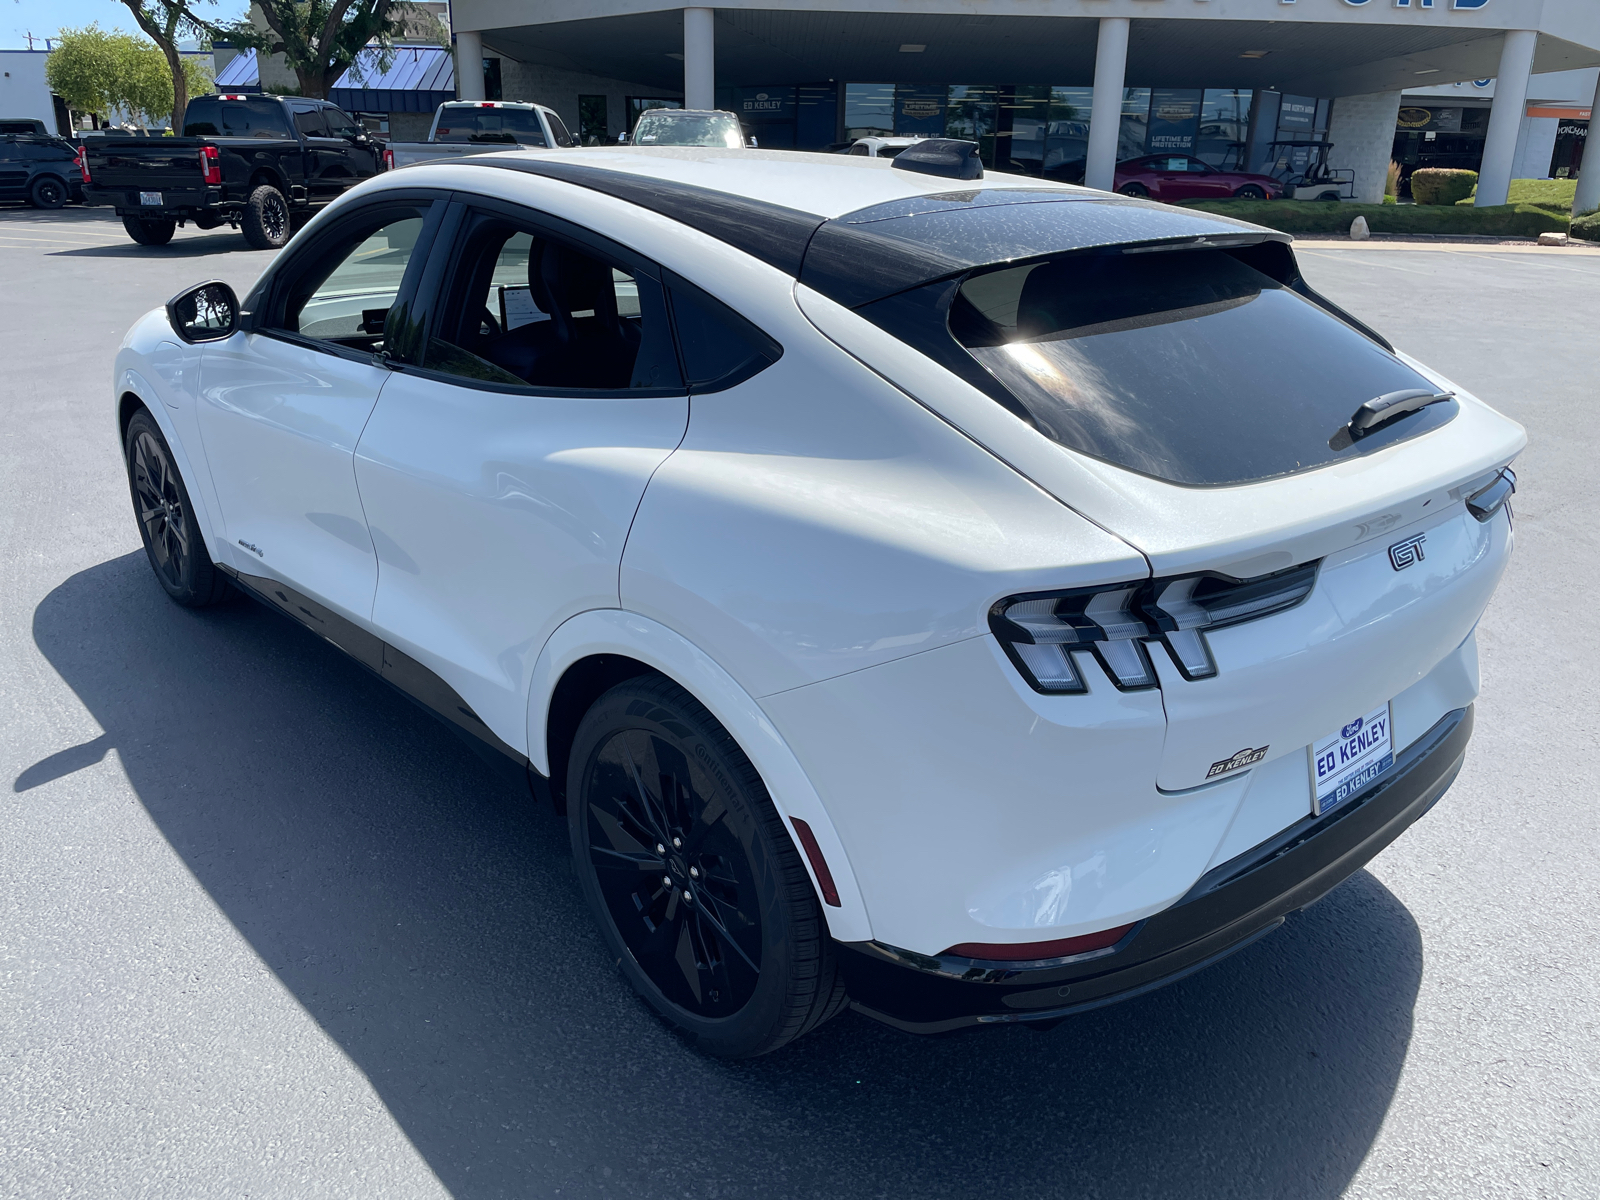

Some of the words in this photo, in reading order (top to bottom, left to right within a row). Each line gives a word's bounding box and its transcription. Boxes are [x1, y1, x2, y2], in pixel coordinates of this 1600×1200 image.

[743, 102, 753, 110] ED
[754, 101, 781, 109] KENLEY
[1388, 531, 1427, 572] GT
[1209, 764, 1225, 776] ED
[1225, 750, 1267, 771] KENLEY
[1317, 751, 1336, 778] ED
[1339, 718, 1386, 765] KENLEY
[1335, 786, 1348, 801] ED
[1350, 761, 1381, 793] KENLEY
